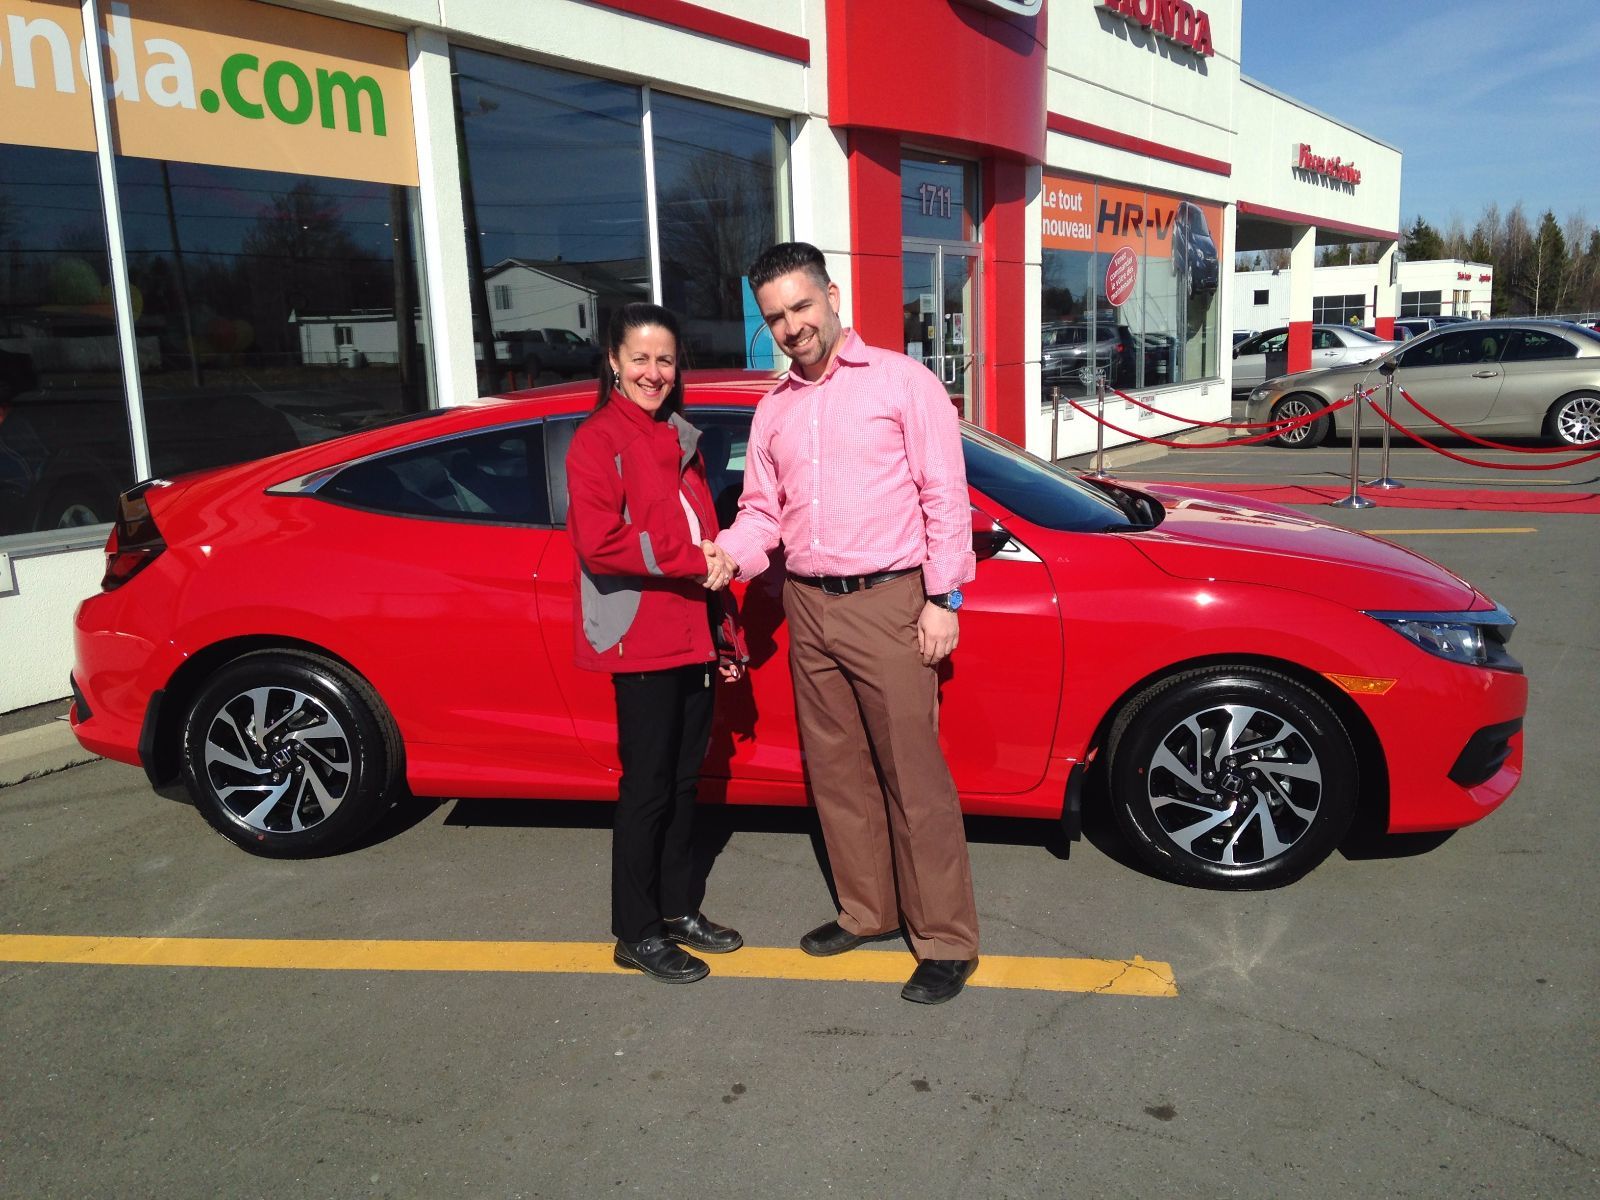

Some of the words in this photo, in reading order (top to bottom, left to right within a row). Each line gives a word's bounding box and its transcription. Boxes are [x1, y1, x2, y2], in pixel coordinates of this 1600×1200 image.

[0, 1, 388, 137] nda.com
[919, 182, 951, 218] 1711
[1042, 184, 1056, 208] Le
[1058, 188, 1082, 211] tout
[1042, 218, 1091, 240] nouveau
[1096, 199, 1175, 241] HR-V
